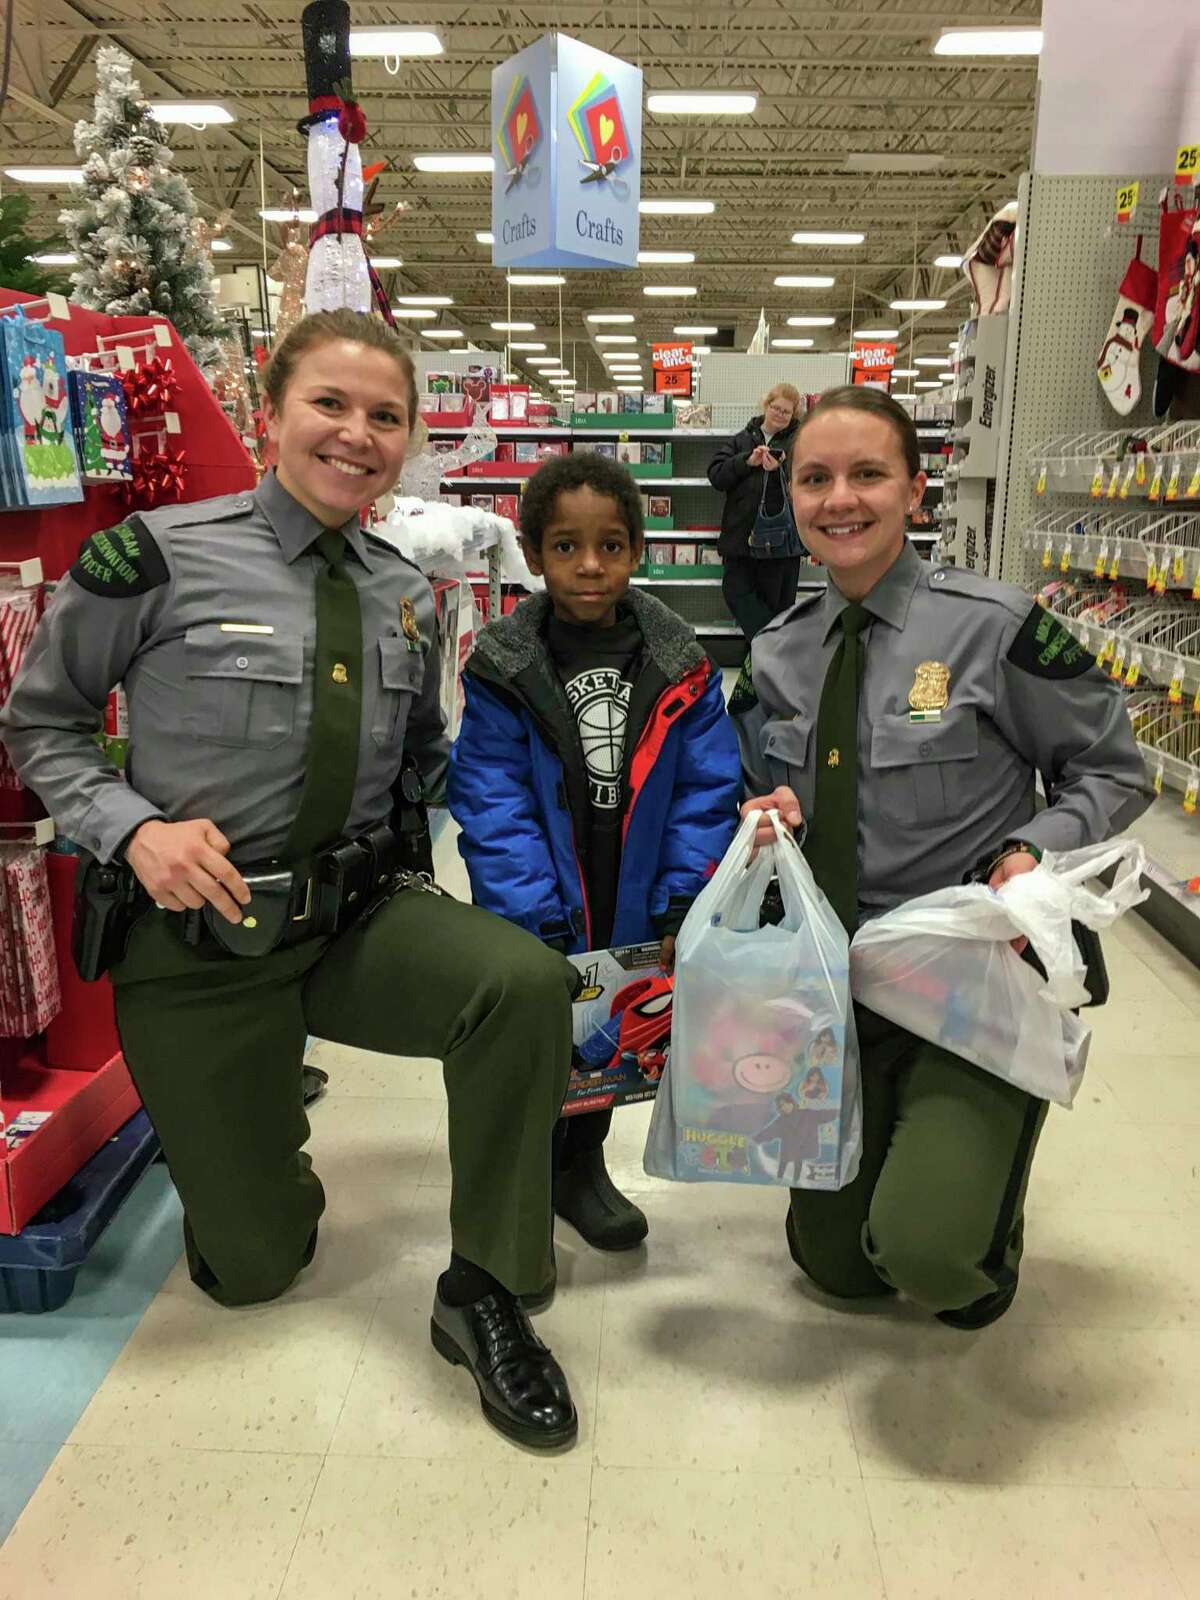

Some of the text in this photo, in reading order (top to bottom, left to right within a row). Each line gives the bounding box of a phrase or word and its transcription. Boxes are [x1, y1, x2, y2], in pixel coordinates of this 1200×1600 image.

[502, 212, 537, 245] Crafts
[576, 210, 624, 246] Crafts
[662, 354, 694, 368] ance
[863, 355, 895, 368] ance
[979, 364, 997, 429] Energizer
[965, 525, 979, 570] ergizer
